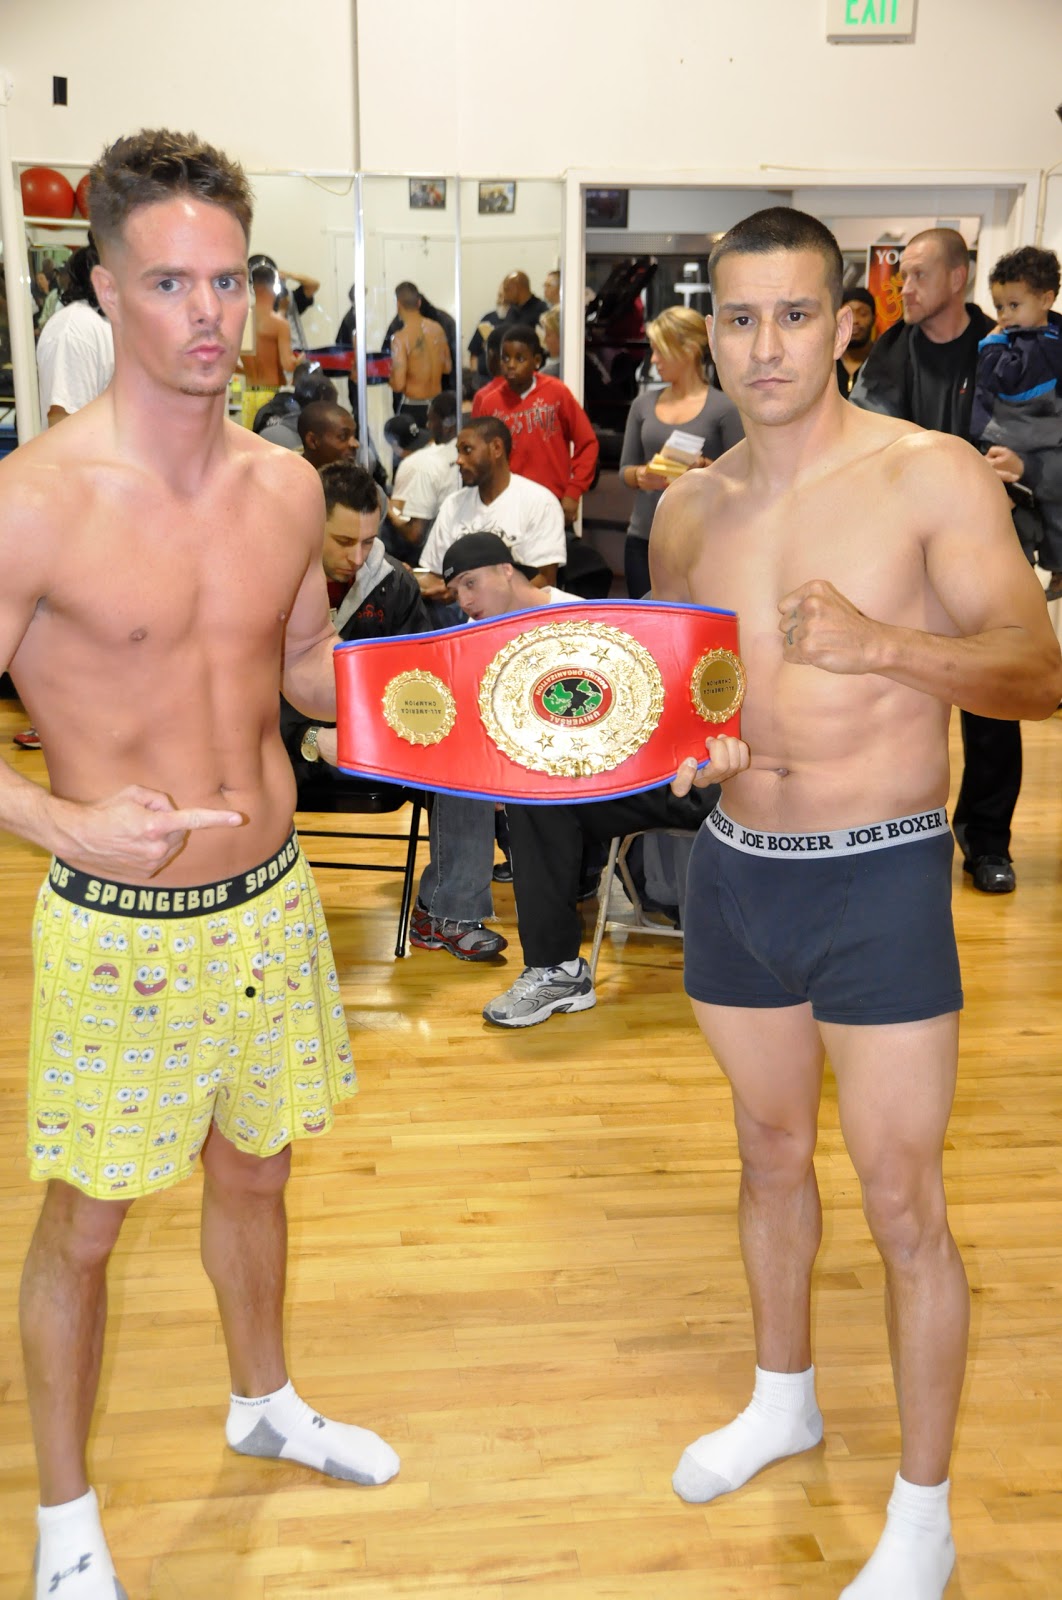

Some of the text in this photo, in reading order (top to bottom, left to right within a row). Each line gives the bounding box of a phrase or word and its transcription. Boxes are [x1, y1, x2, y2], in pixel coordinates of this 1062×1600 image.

[876, 249, 904, 265] YO
[535, 669, 583, 696] ORGANIZATION
[549, 710, 600, 726] UNIVERSAL
[846, 826, 883, 847] JOE
[886, 812, 942, 838] BOXER
[740, 830, 833, 851] JOE BOXER
